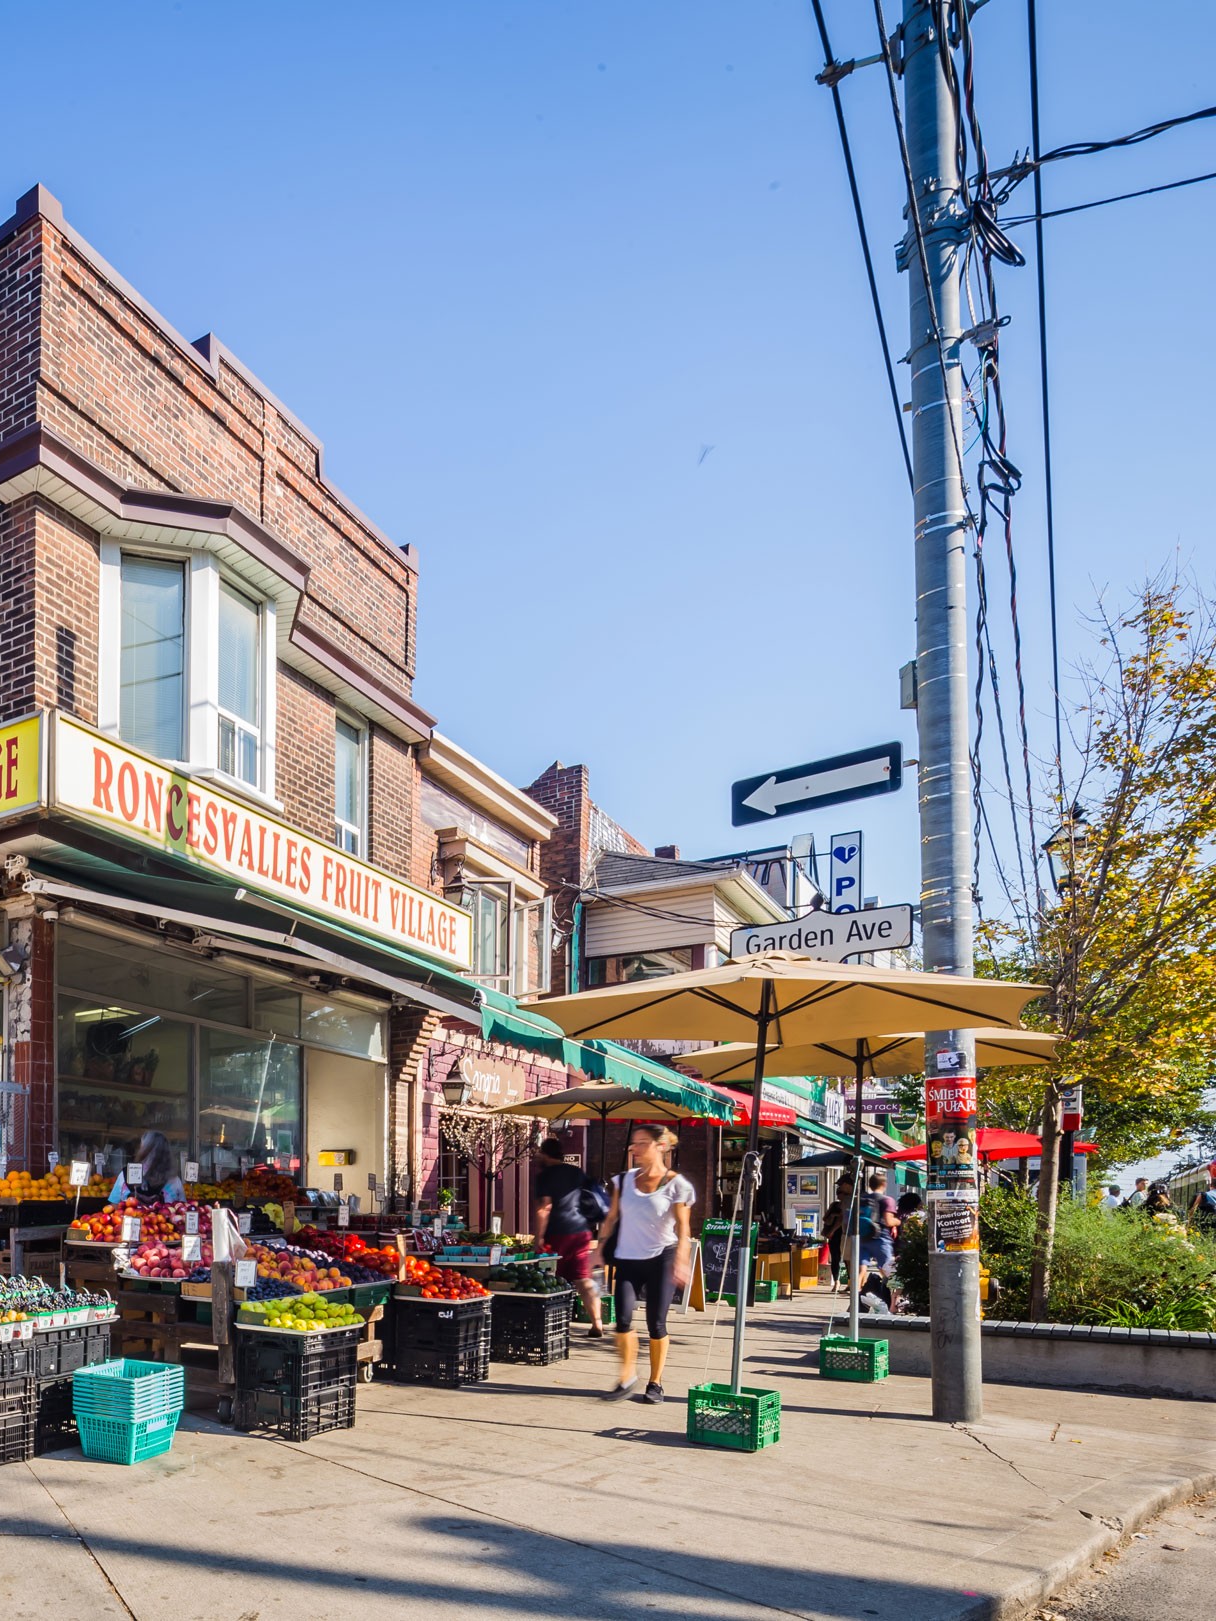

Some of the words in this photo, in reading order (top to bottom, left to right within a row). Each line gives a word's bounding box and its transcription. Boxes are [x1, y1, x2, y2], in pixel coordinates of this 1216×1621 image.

[92, 747, 311, 894] RONCESVALLES
[321, 855, 382, 924] FRUIT
[389, 887, 456, 955] VILLAGE
[746, 928, 834, 954] Garden
[846, 919, 893, 943] Ave
[848, 1103, 873, 1111] wne
[875, 1102, 898, 1111] rack
[937, 1217, 971, 1228] Koncert
